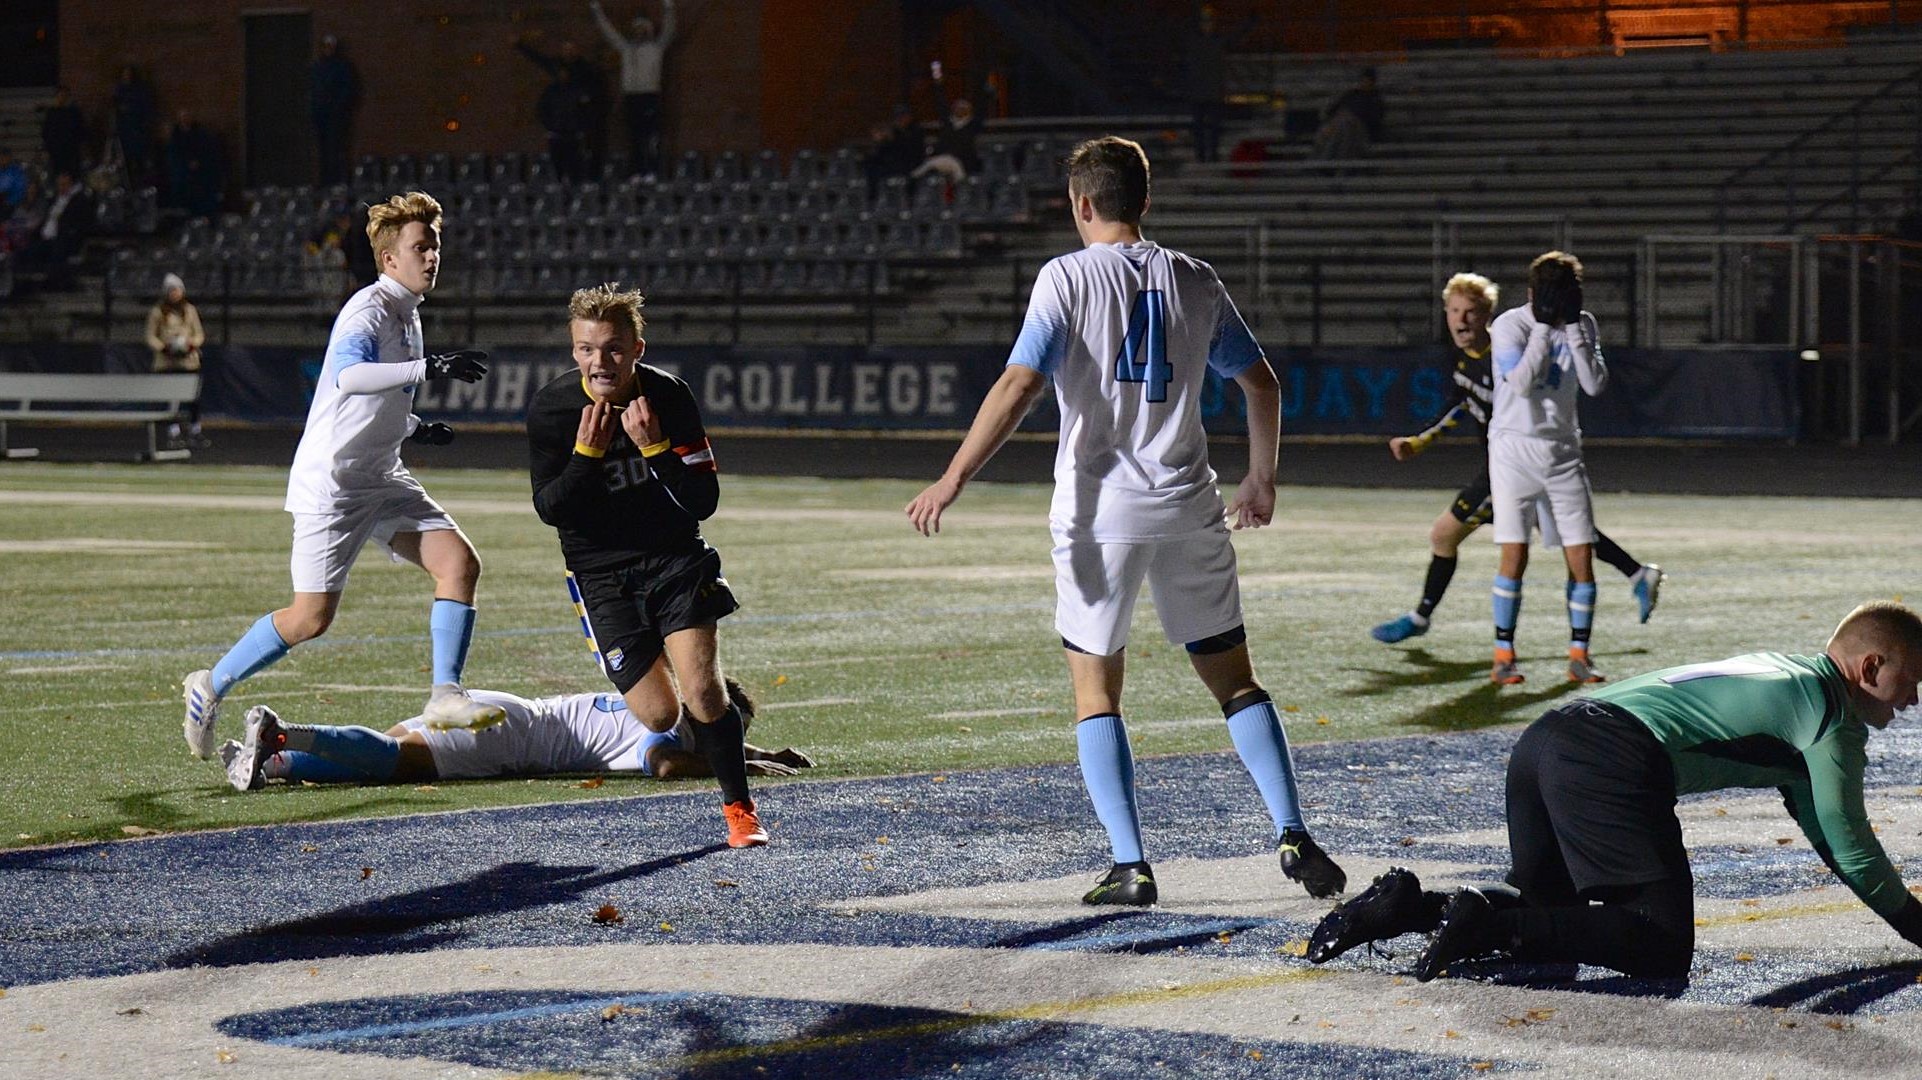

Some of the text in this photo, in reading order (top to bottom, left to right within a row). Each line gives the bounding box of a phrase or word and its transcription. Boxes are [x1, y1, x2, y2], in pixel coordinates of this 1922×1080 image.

[1115, 289, 1173, 403] 4
[703, 362, 959, 413] COLLEGE
[1202, 365, 1447, 417] JAYS
[603, 456, 649, 492] 30
